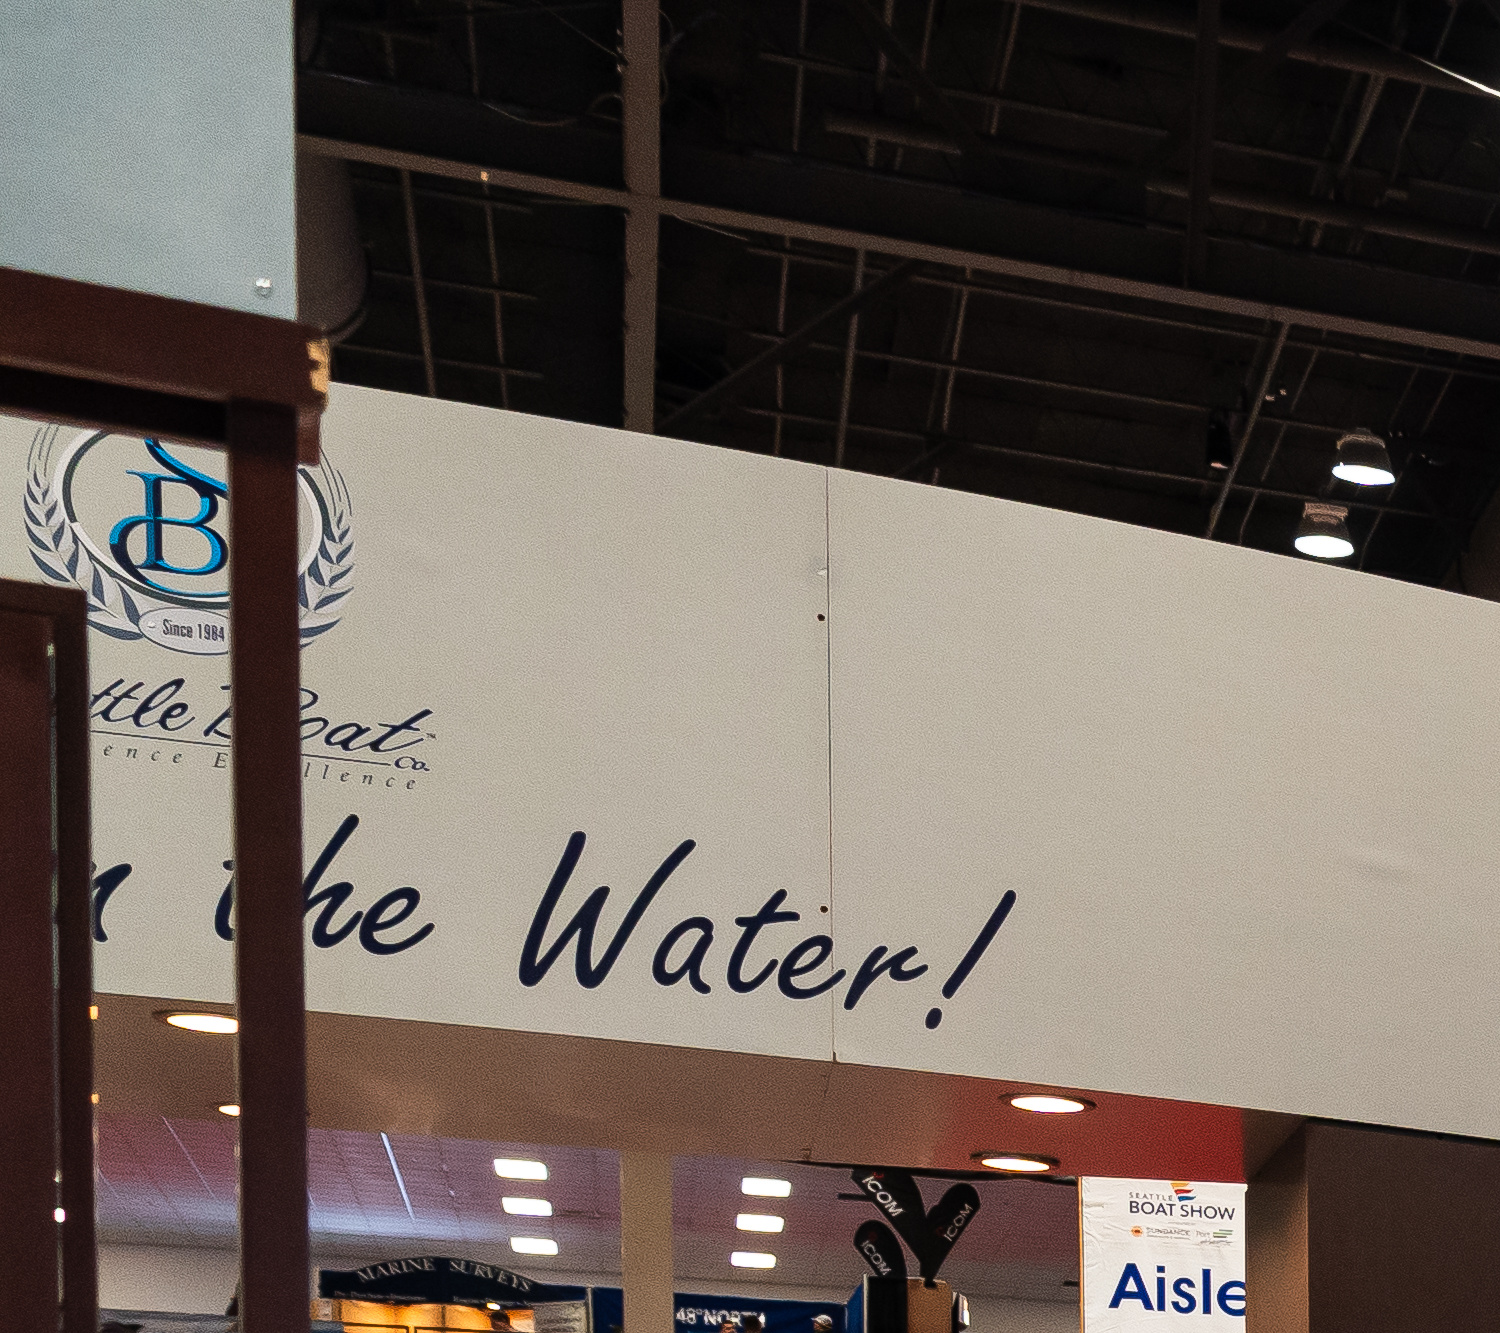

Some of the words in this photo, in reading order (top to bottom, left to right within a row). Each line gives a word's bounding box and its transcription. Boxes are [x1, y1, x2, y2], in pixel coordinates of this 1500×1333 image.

[162, 618, 193, 639] Since
[197, 622, 226, 642] 1984
[89, 677, 196, 732] ttle
[518, 831, 1017, 1030] Water!
[862, 1175, 905, 1219] ICOM
[1128, 1191, 1174, 1202] SEATTLE
[1129, 1201, 1176, 1216] BOAT
[1180, 1204, 1235, 1220] SHOW
[943, 1202, 974, 1243] ICOM
[357, 1257, 437, 1284] MARINE
[450, 1259, 535, 1293] SURVEYS
[859, 1239, 893, 1277] ICOM
[1108, 1262, 1246, 1317] Aisle
